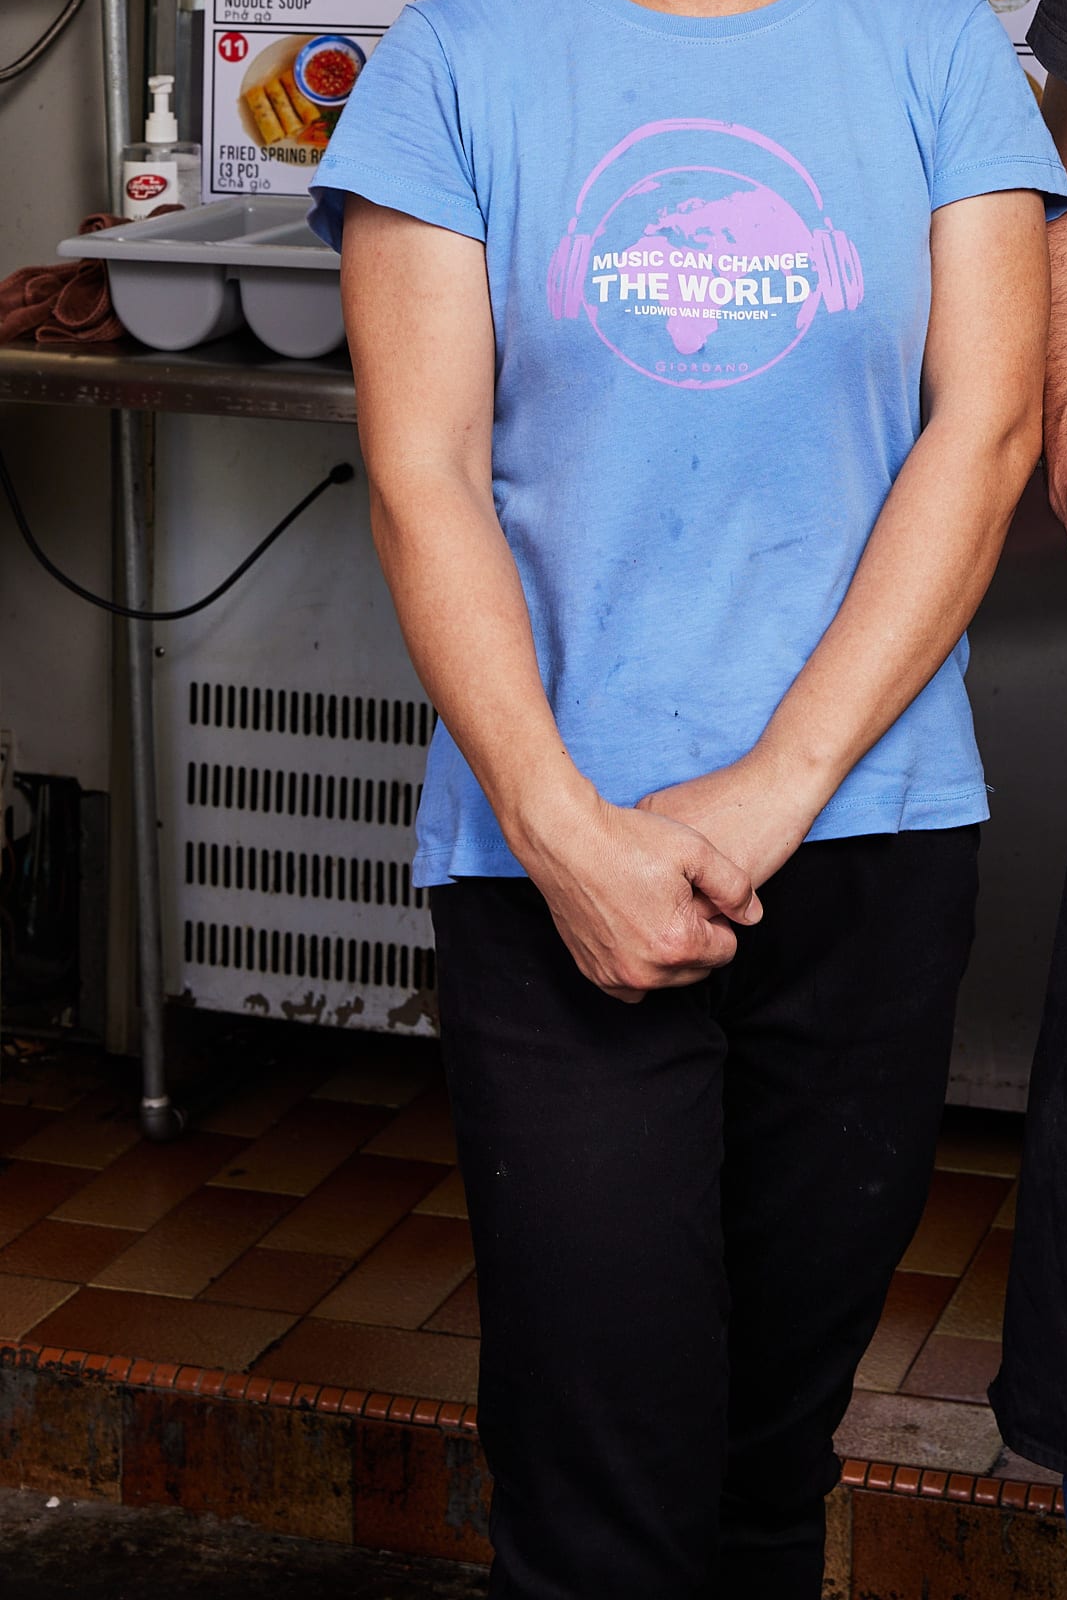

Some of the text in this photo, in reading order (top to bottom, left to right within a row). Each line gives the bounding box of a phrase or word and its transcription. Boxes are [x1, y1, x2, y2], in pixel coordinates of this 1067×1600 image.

[221, 39, 244, 57] 11
[220, 145, 256, 161] FRIED
[260, 147, 307, 163] SPRING
[237, 164, 259, 178] PC)
[592, 251, 809, 272] MUSIC CAN CHANGE
[592, 273, 811, 306] THE WORLD
[634, 306, 677, 317] LUDWIG
[679, 307, 700, 318] VAN
[702, 309, 768, 320] BEETHOVEN
[655, 361, 750, 373] GIORDANO
